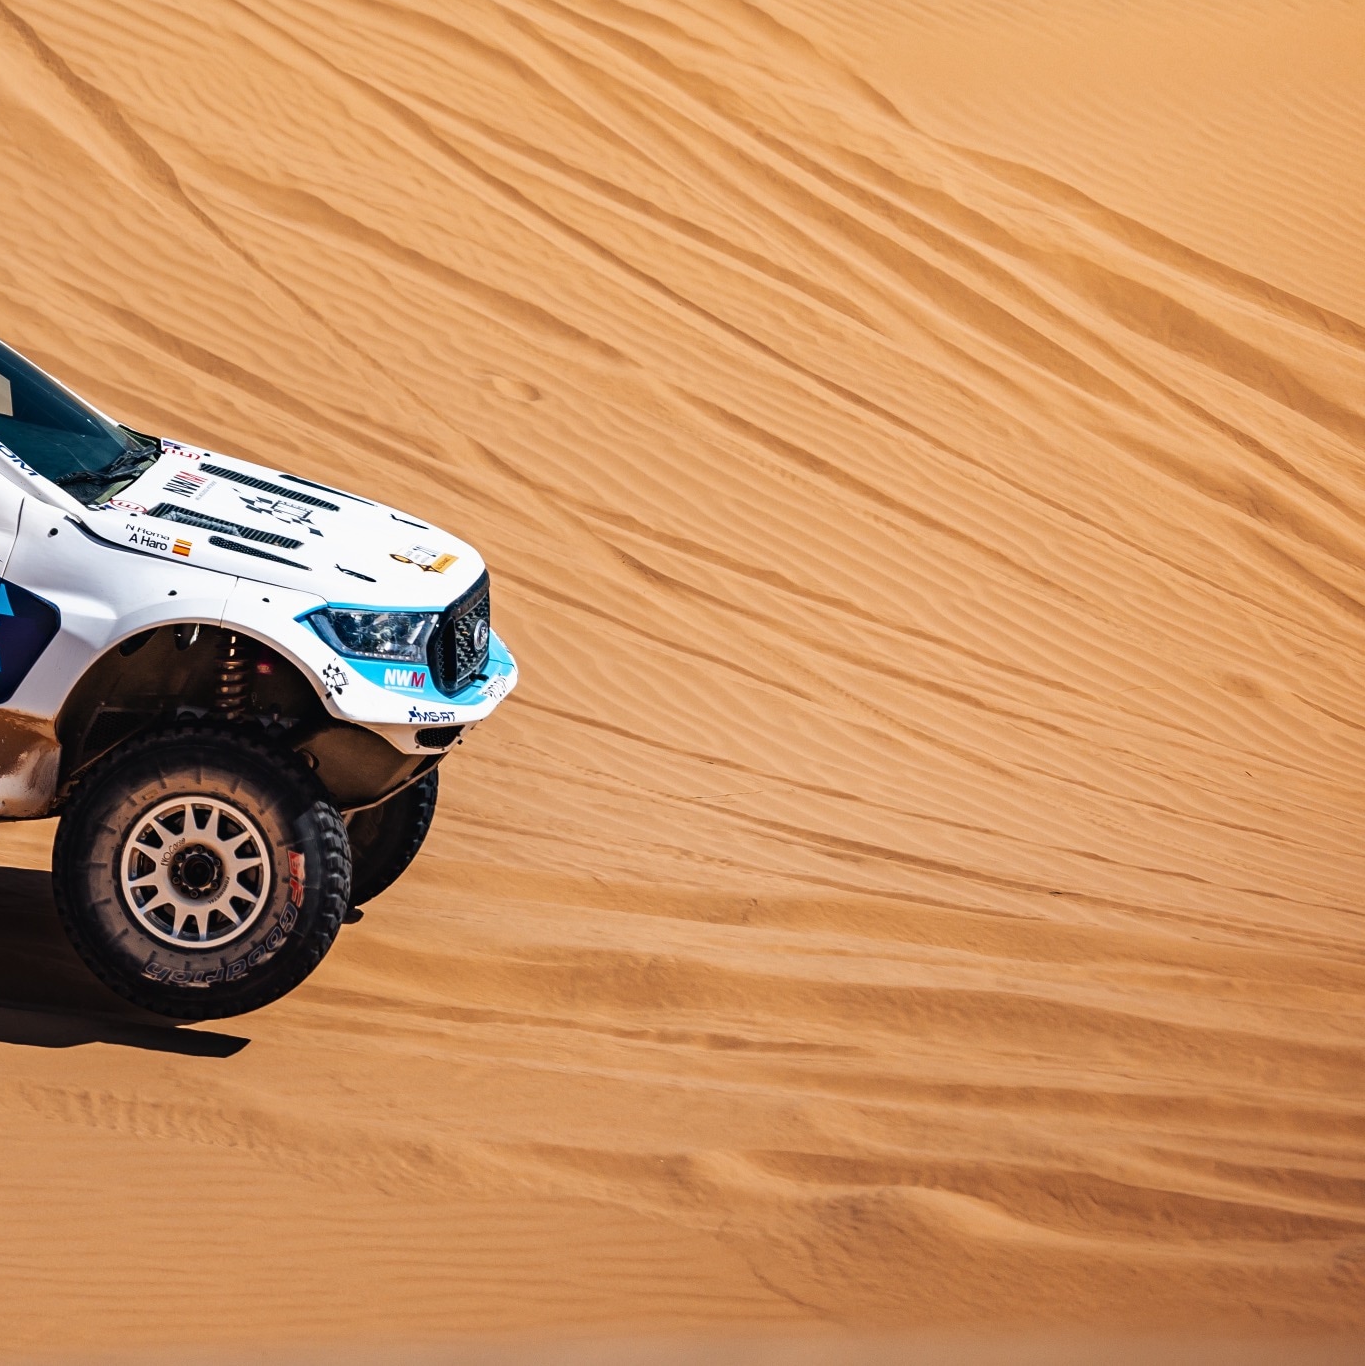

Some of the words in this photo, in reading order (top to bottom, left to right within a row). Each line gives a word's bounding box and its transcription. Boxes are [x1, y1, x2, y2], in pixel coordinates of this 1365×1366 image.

[162, 470, 209, 498] NWM
[125, 523, 135, 531] N
[129, 533, 138, 544] A
[140, 537, 168, 551] Haro
[383, 668, 426, 688] NWM
[418, 711, 456, 722] MS-RT
[140, 850, 306, 989] BFGoodrich
